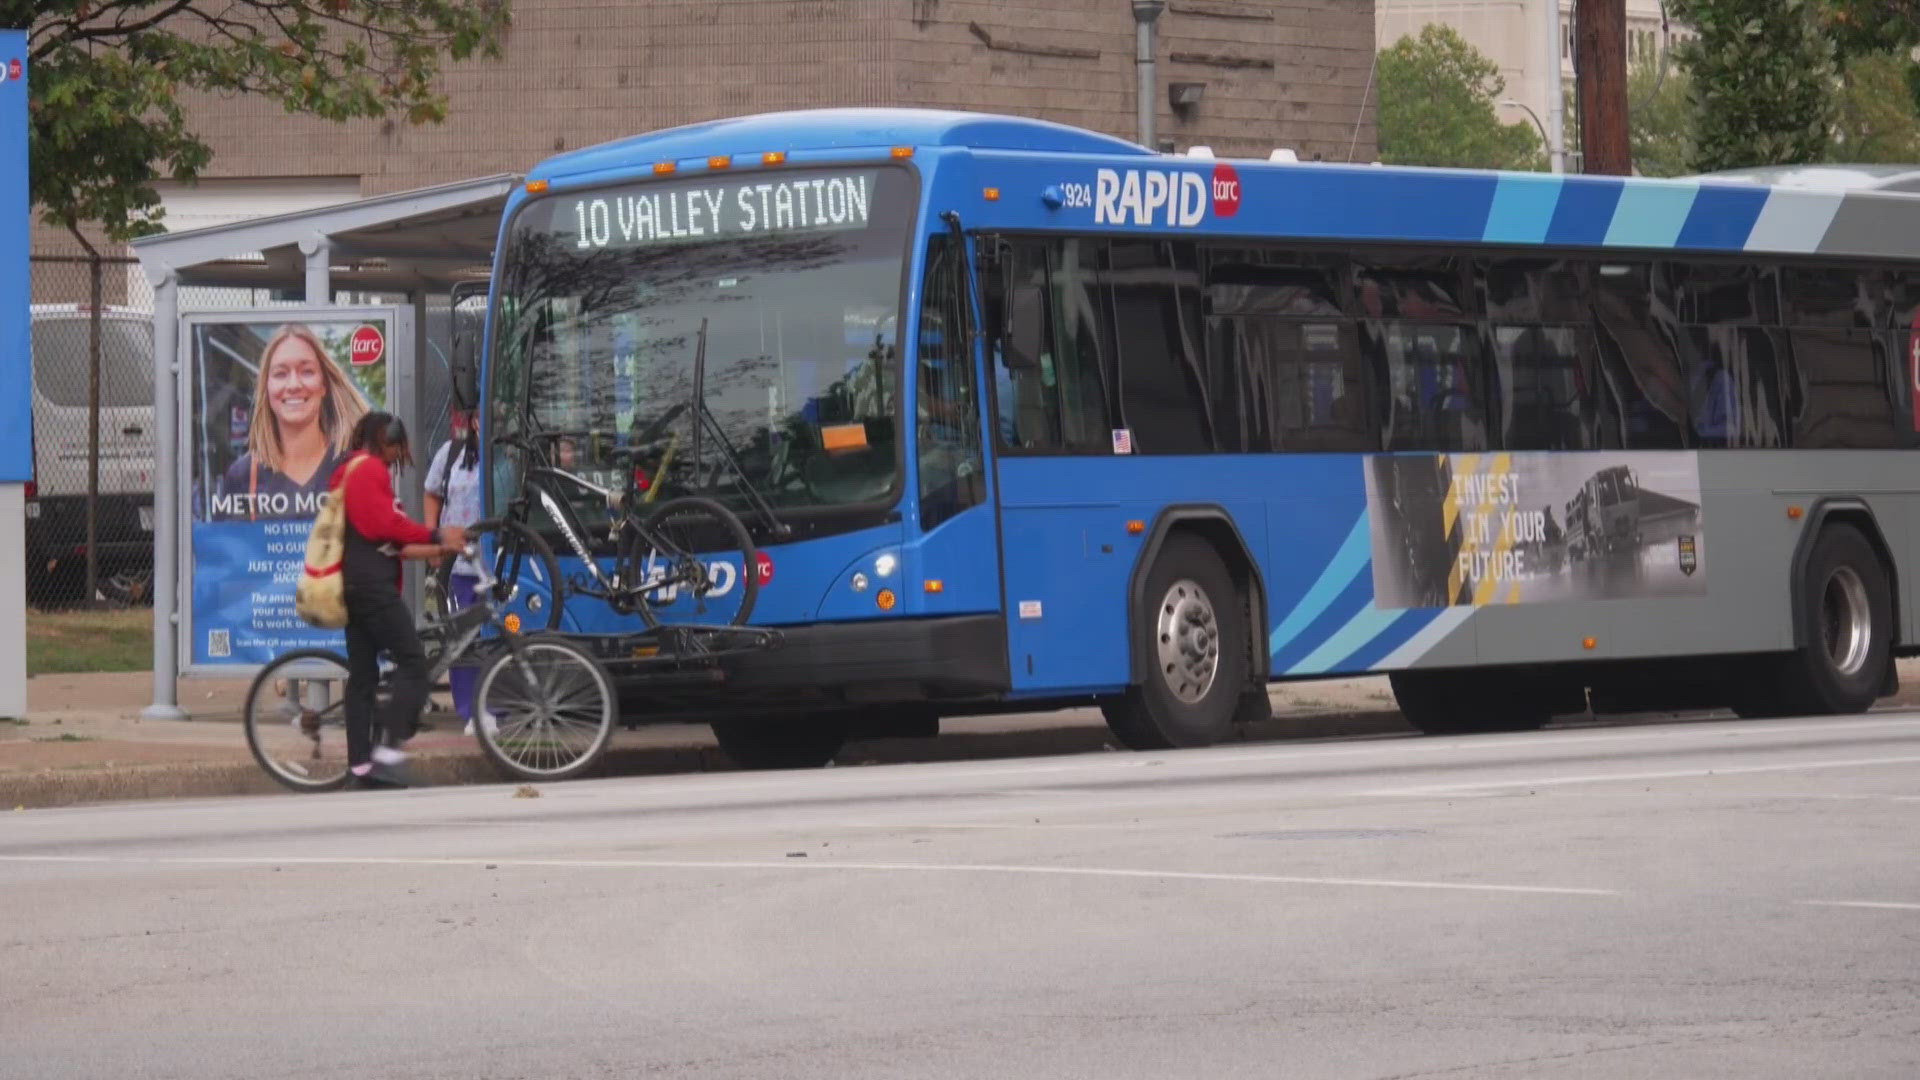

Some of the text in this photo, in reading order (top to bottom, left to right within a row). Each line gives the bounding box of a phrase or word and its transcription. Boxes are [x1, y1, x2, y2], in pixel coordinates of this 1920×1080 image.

[1094, 168, 1207, 227] RAPID
[1213, 176, 1239, 201] tarc
[575, 176, 868, 249] 10 VALLEY STATION
[353, 336, 380, 353] tarc
[1452, 473, 1520, 505] INVEST
[211, 491, 333, 515] METRO MO
[264, 523, 280, 536] NO
[1467, 511, 1546, 543] IN YOUR
[267, 542, 284, 554] NO
[248, 560, 274, 573] JUST
[1458, 550, 1536, 582] FUTURE.
[266, 619, 293, 629] work
